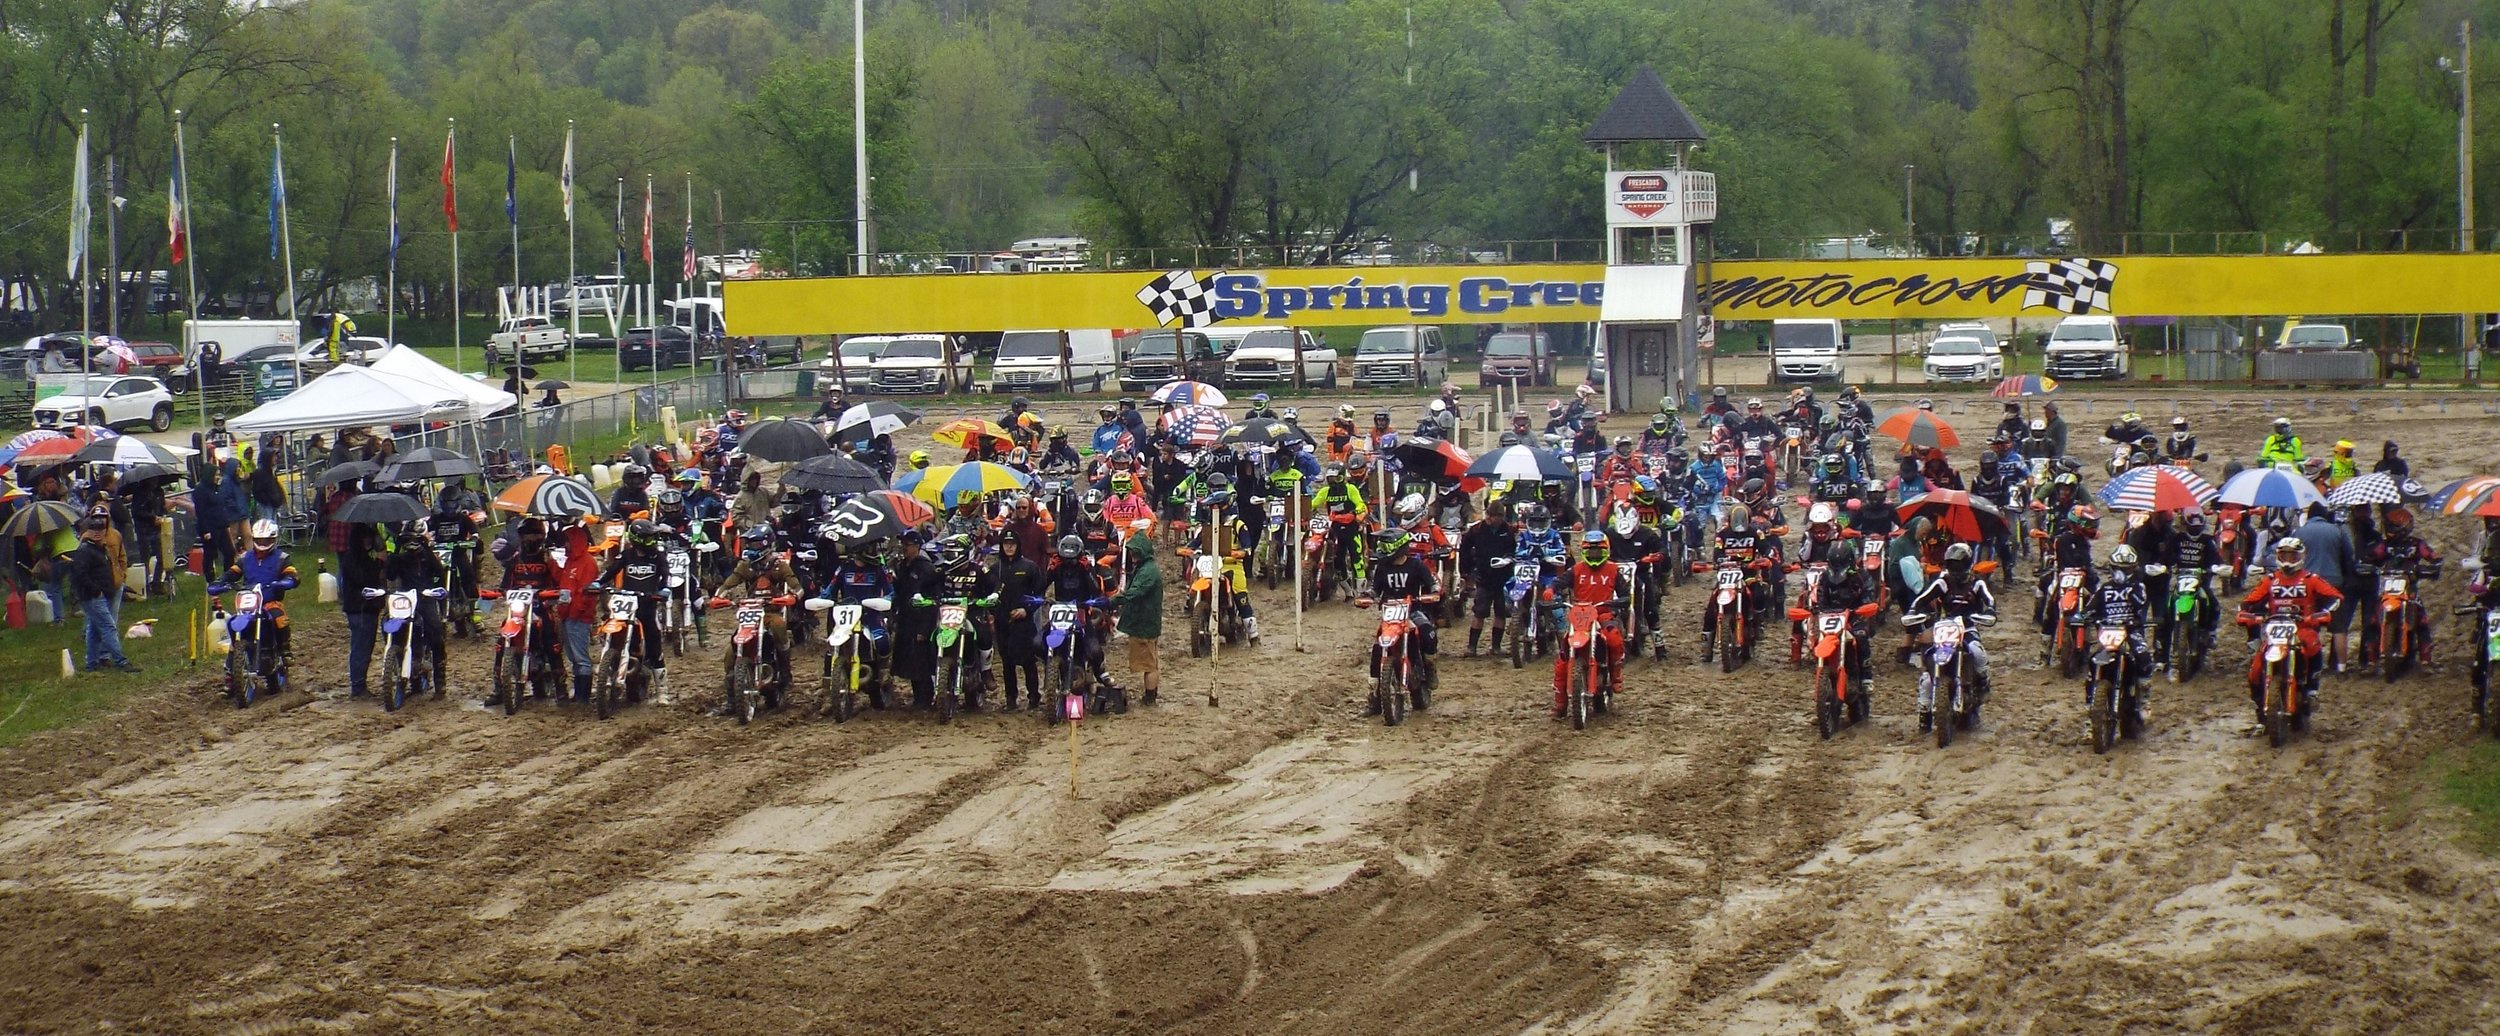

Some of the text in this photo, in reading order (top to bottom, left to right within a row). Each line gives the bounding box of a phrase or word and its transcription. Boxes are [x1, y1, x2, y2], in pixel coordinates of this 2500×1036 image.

[1622, 193, 1667, 202] SPRING CREEK
[1213, 274, 1450, 319] Spring
[1458, 277, 1606, 314] Cree
[1825, 484, 1847, 495] FXR
[1111, 505, 1136, 513] FXR
[1408, 532, 1430, 543] XR
[1725, 537, 1754, 547] FXR
[1516, 566, 1537, 578] 455
[1387, 573, 1408, 588] FLY
[1579, 575, 1609, 585] FLY
[2179, 578, 2199, 592] 12
[2272, 585, 2307, 598] FXR
[613, 599, 633, 614] 34
[840, 610, 853, 625] 31
[1824, 617, 1840, 631] 9
[2270, 625, 2295, 639] 428
